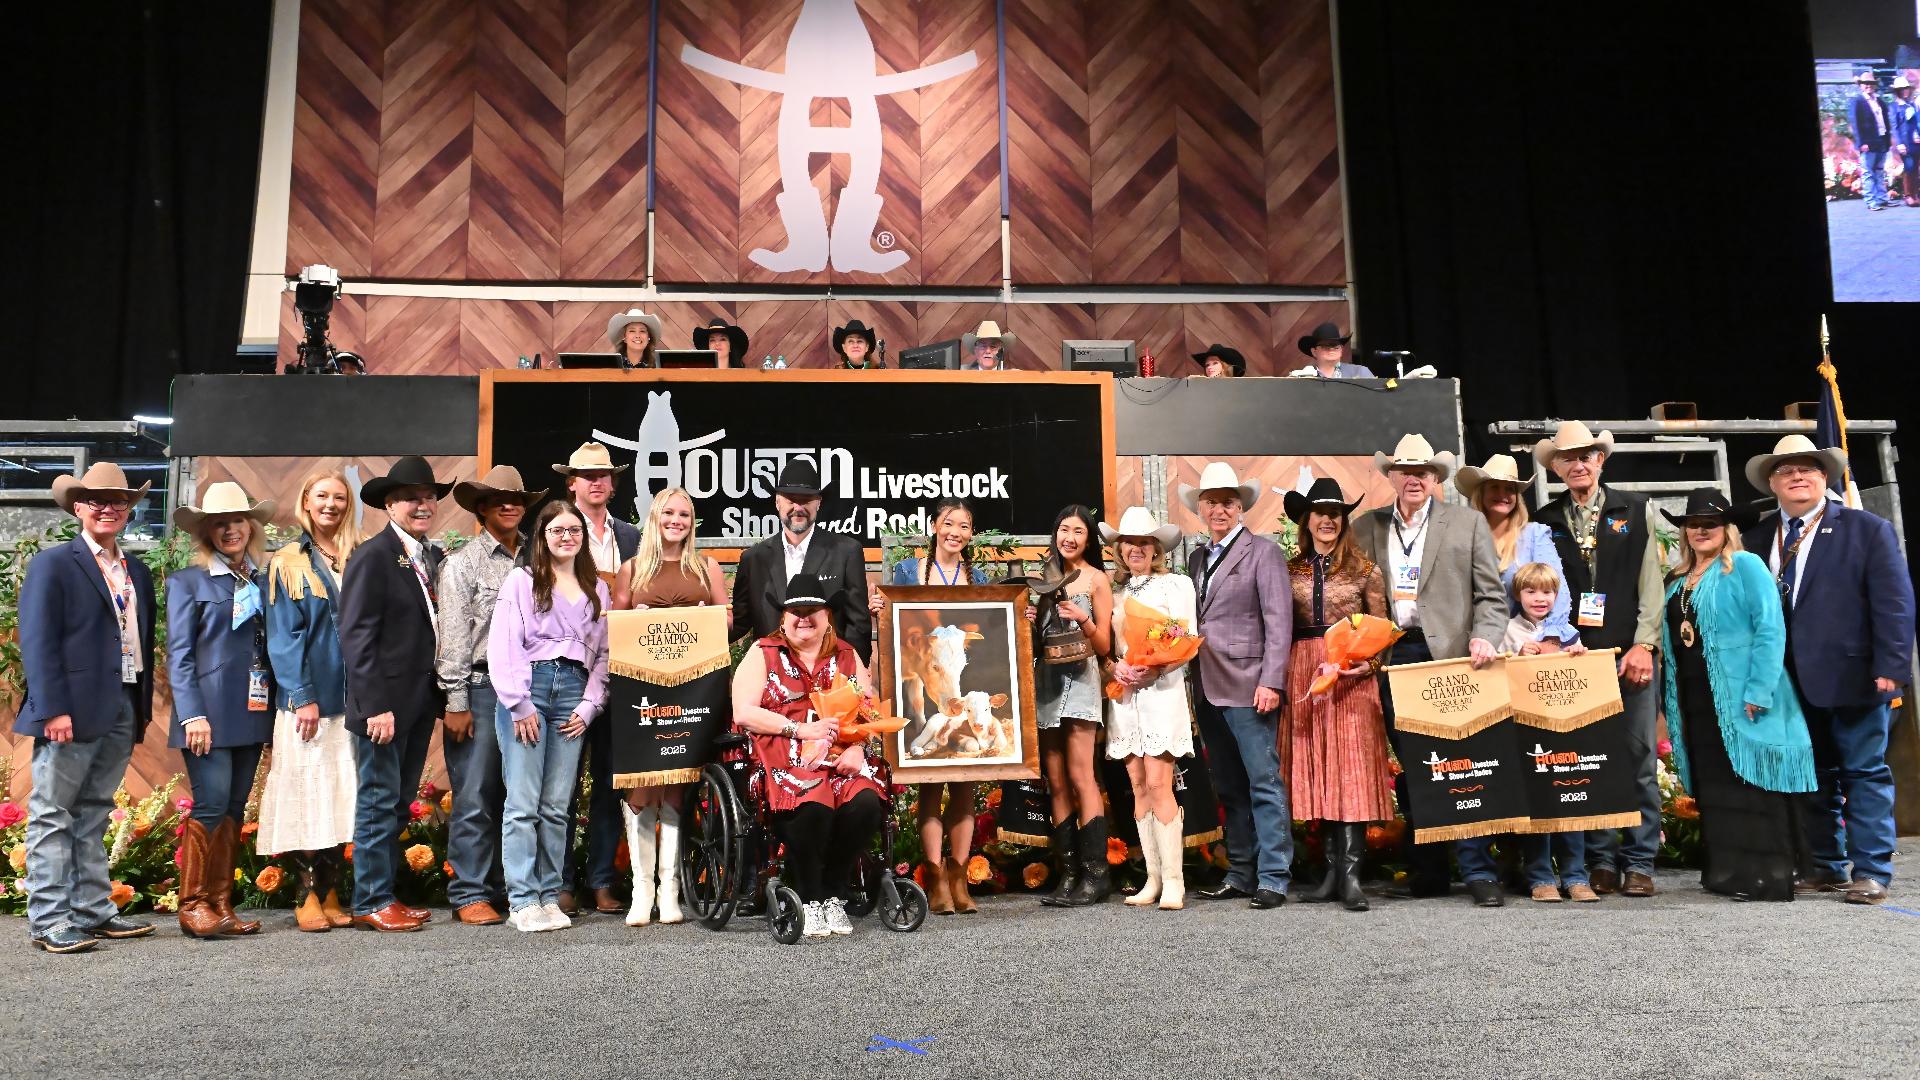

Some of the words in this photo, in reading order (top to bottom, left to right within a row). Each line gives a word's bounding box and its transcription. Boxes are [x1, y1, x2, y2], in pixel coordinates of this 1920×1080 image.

[860, 467, 1010, 499] Livestock
[721, 506, 782, 538] Sho
[866, 506, 937, 539] Rod
[647, 621, 689, 635] GRAND
[638, 632, 698, 647] CHAMPION
[1428, 673, 1470, 689] GRAND
[1535, 668, 1578, 682] GRAND
[1421, 683, 1480, 701] CHAMPION
[1528, 678, 1588, 693] CHAMPION
[682, 706, 711, 716] Livestock
[656, 718, 673, 726] Show
[683, 715, 702, 724] Rodeo
[660, 744, 687, 756] 2025
[1472, 758, 1500, 770] Livestock
[1578, 753, 1608, 763] Livestock
[1553, 764, 1570, 773] Show
[1580, 762, 1601, 771] Rodeo
[1448, 772, 1465, 781] Show
[1474, 768, 1493, 778] Rodeo
[1560, 791, 1588, 803] 2025
[1455, 798, 1482, 811] 2025
